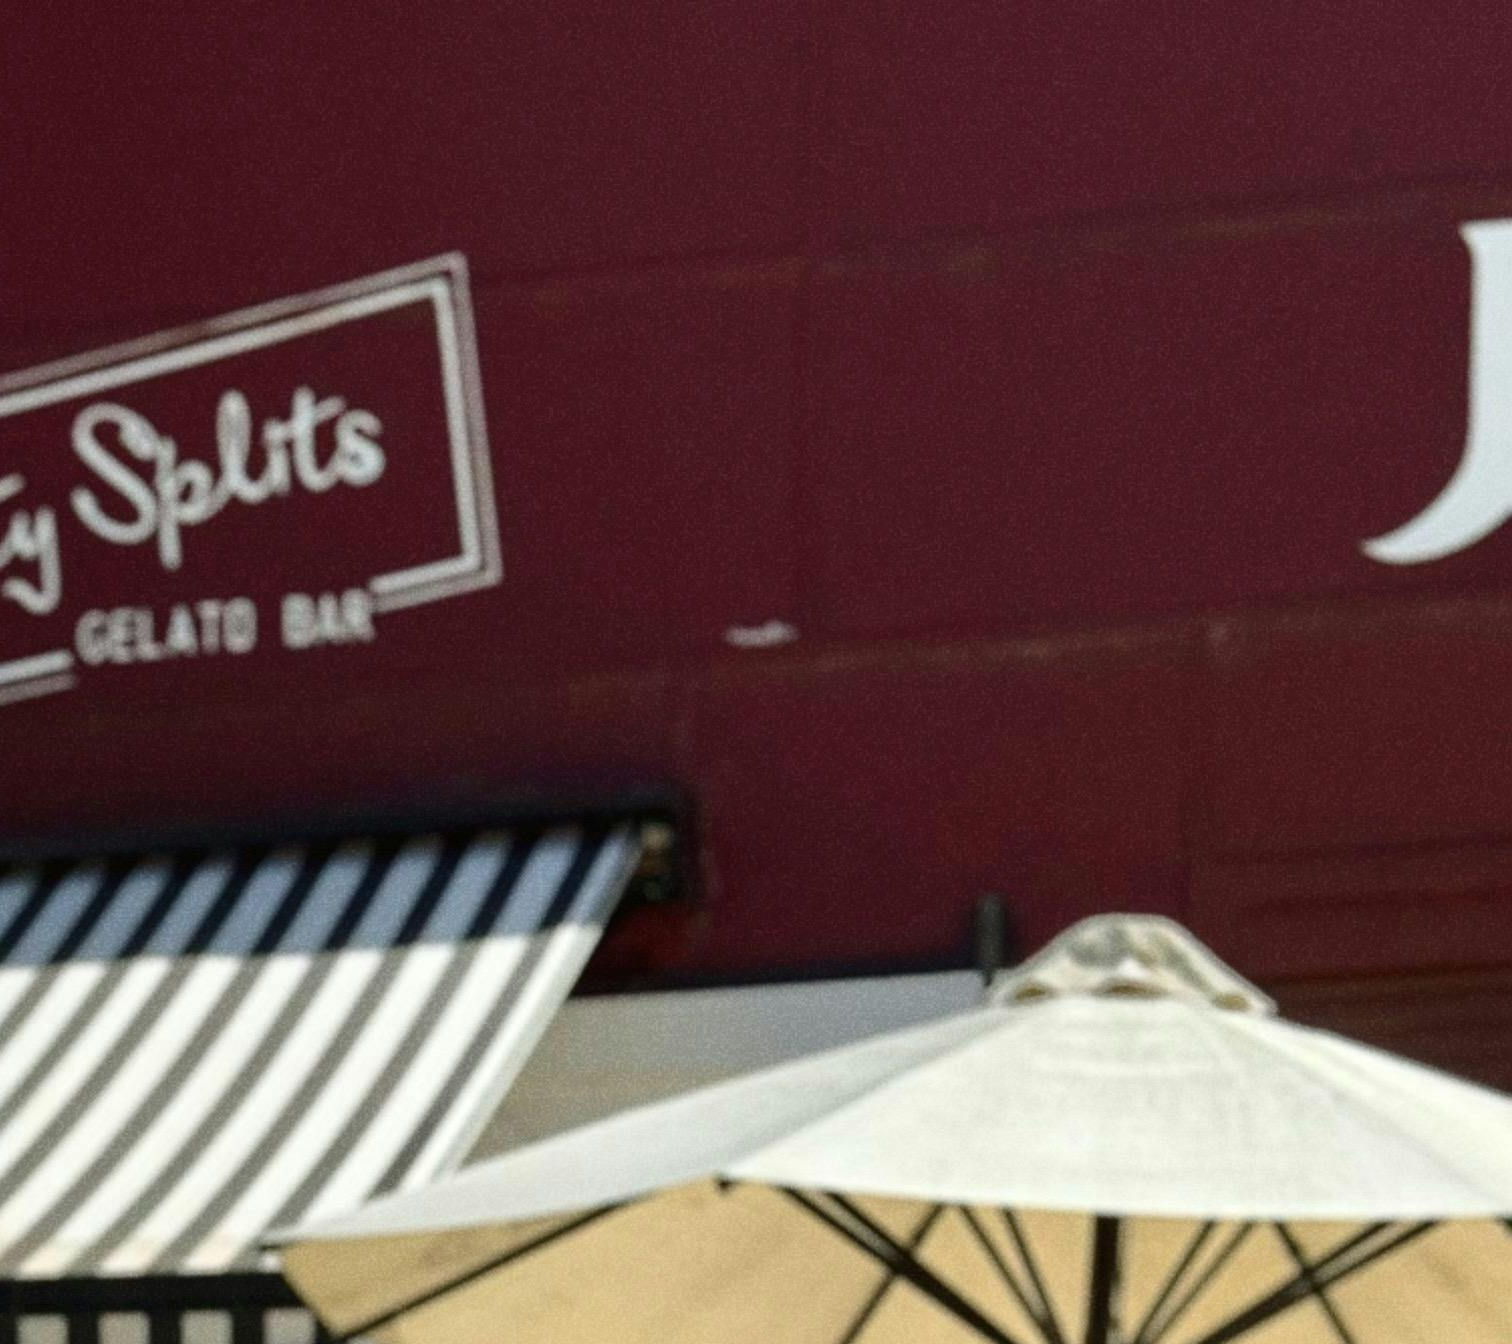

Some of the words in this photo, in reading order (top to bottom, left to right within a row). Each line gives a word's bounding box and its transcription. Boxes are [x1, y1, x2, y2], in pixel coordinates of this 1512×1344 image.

[69, 386, 386, 570] Splits
[74, 598, 258, 667] GELATO
[280, 588, 376, 650] BAR
